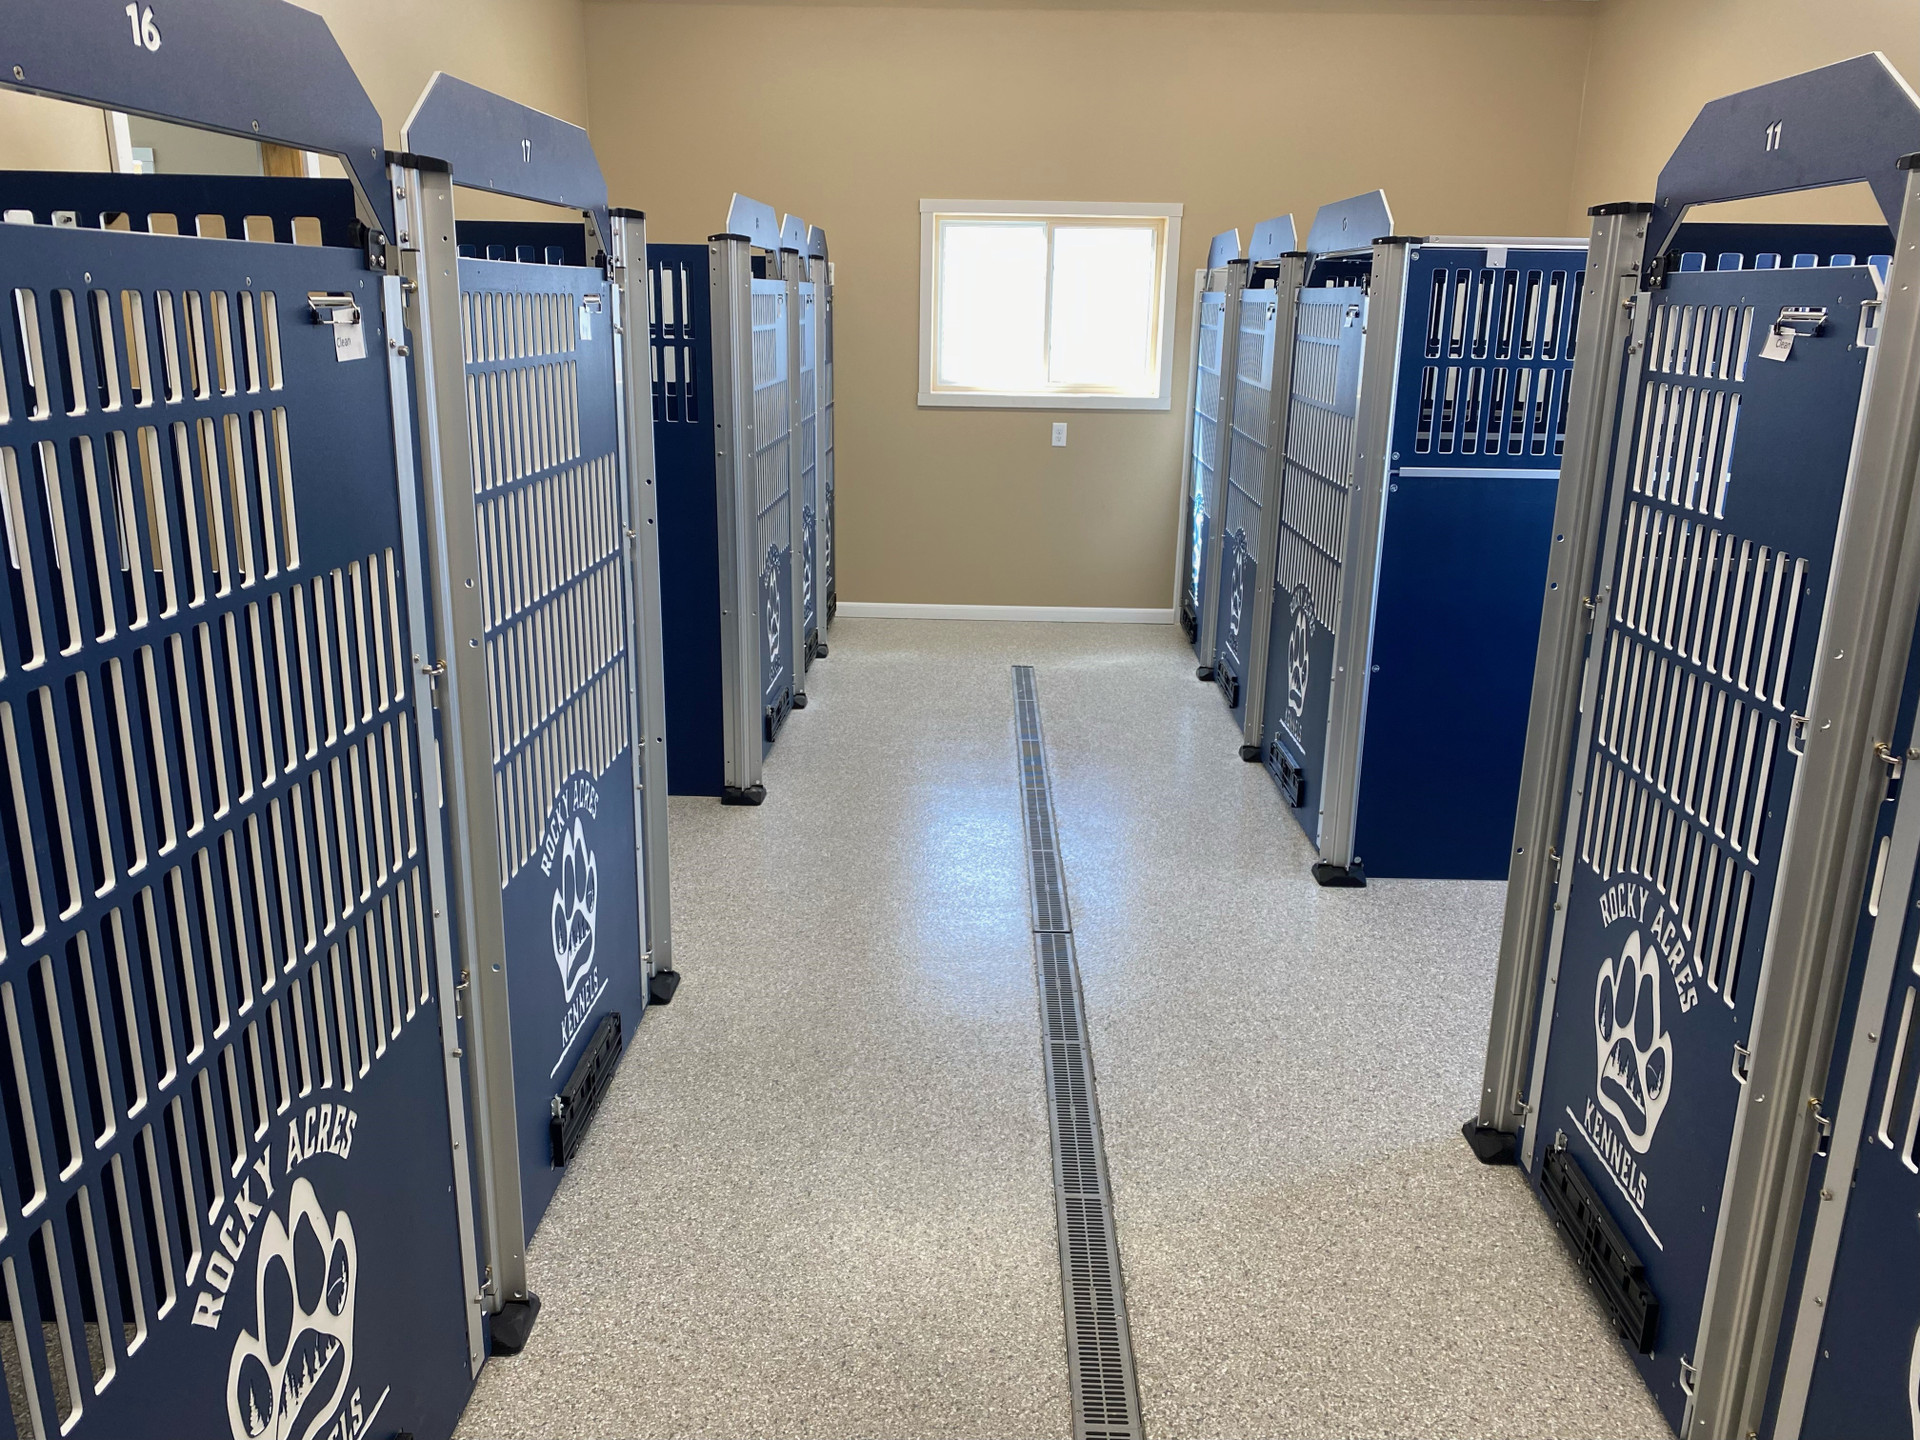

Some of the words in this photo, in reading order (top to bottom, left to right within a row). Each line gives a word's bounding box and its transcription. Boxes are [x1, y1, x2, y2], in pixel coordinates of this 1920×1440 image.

[125, 1, 161, 52] 16
[521, 138, 532, 163] 17
[1765, 119, 1783, 152] 11
[336, 337, 352, 348] Clean
[1775, 338, 1791, 350] Clean
[540, 788, 570, 876] ROCKY
[572, 778, 599, 820] ACRES
[1599, 882, 1650, 928] ROCKY
[1650, 904, 1699, 1013] ACRES
[561, 965, 599, 1048] KENNELS
[1583, 1096, 1648, 1210] KENNELS
[190, 1143, 276, 1331] ROCKY
[285, 1103, 358, 1175] ACRES
